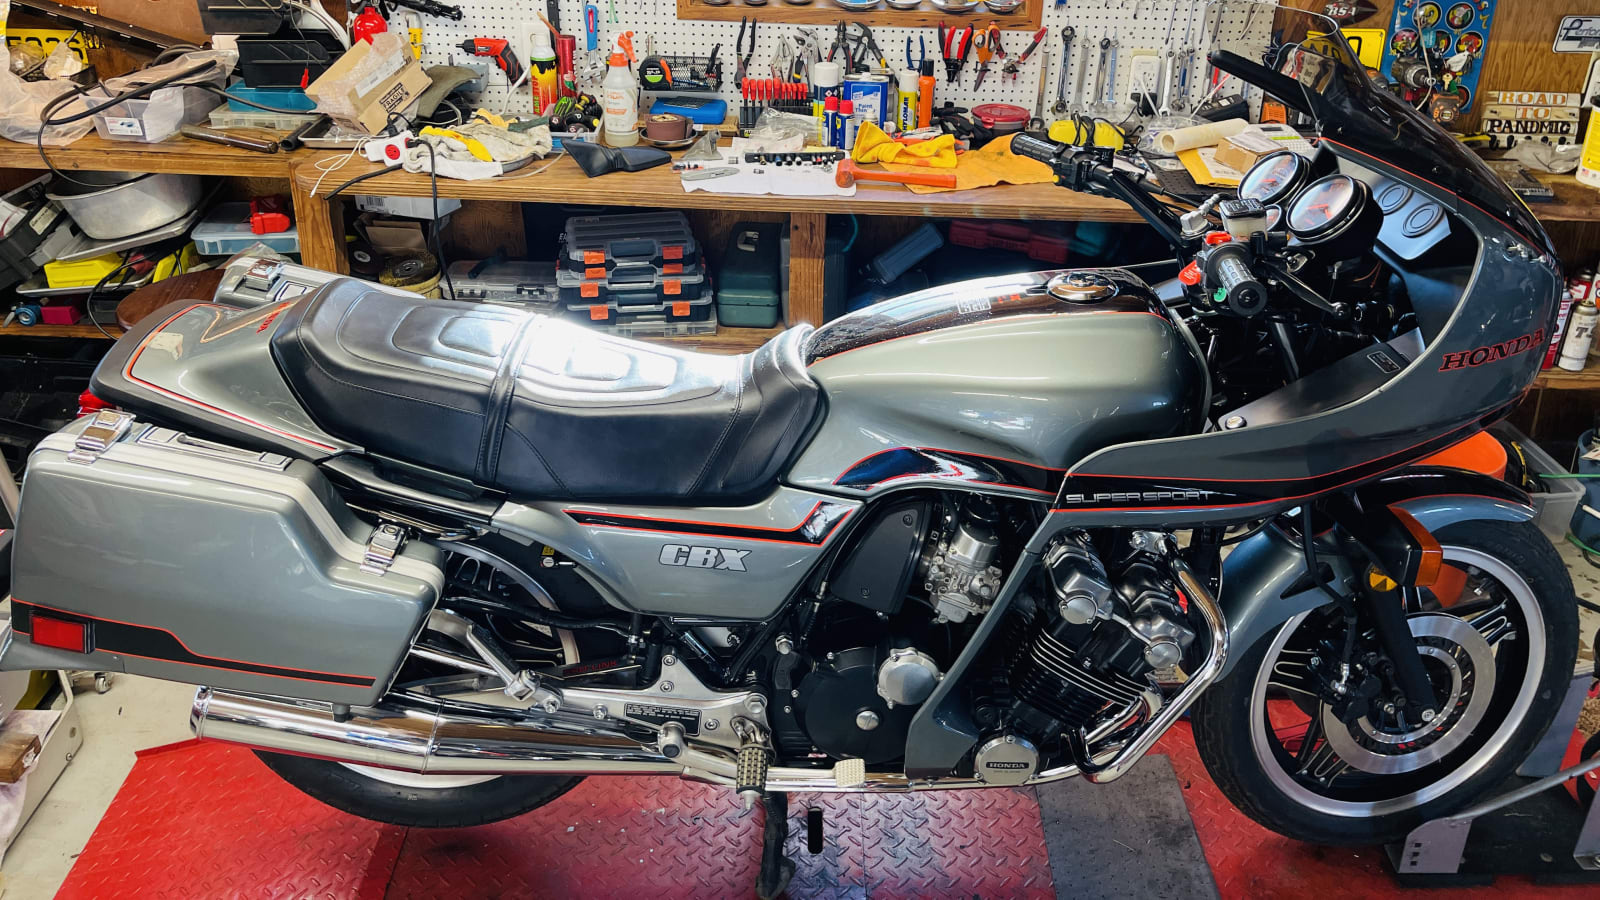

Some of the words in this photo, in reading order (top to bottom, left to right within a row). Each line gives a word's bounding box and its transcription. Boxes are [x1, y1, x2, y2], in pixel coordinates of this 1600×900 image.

[1326, 5, 1356, 16] BSA
[383, 86, 405, 109] FRAGILE
[1501, 92, 1566, 105] ROAD
[1518, 107, 1550, 119] TO
[1487, 120, 1571, 134] PANDMIC
[1438, 328, 1545, 372] HONDA
[1065, 492, 1142, 504] SUPER
[1142, 490, 1209, 501] SPORT
[658, 543, 753, 573] CBX
